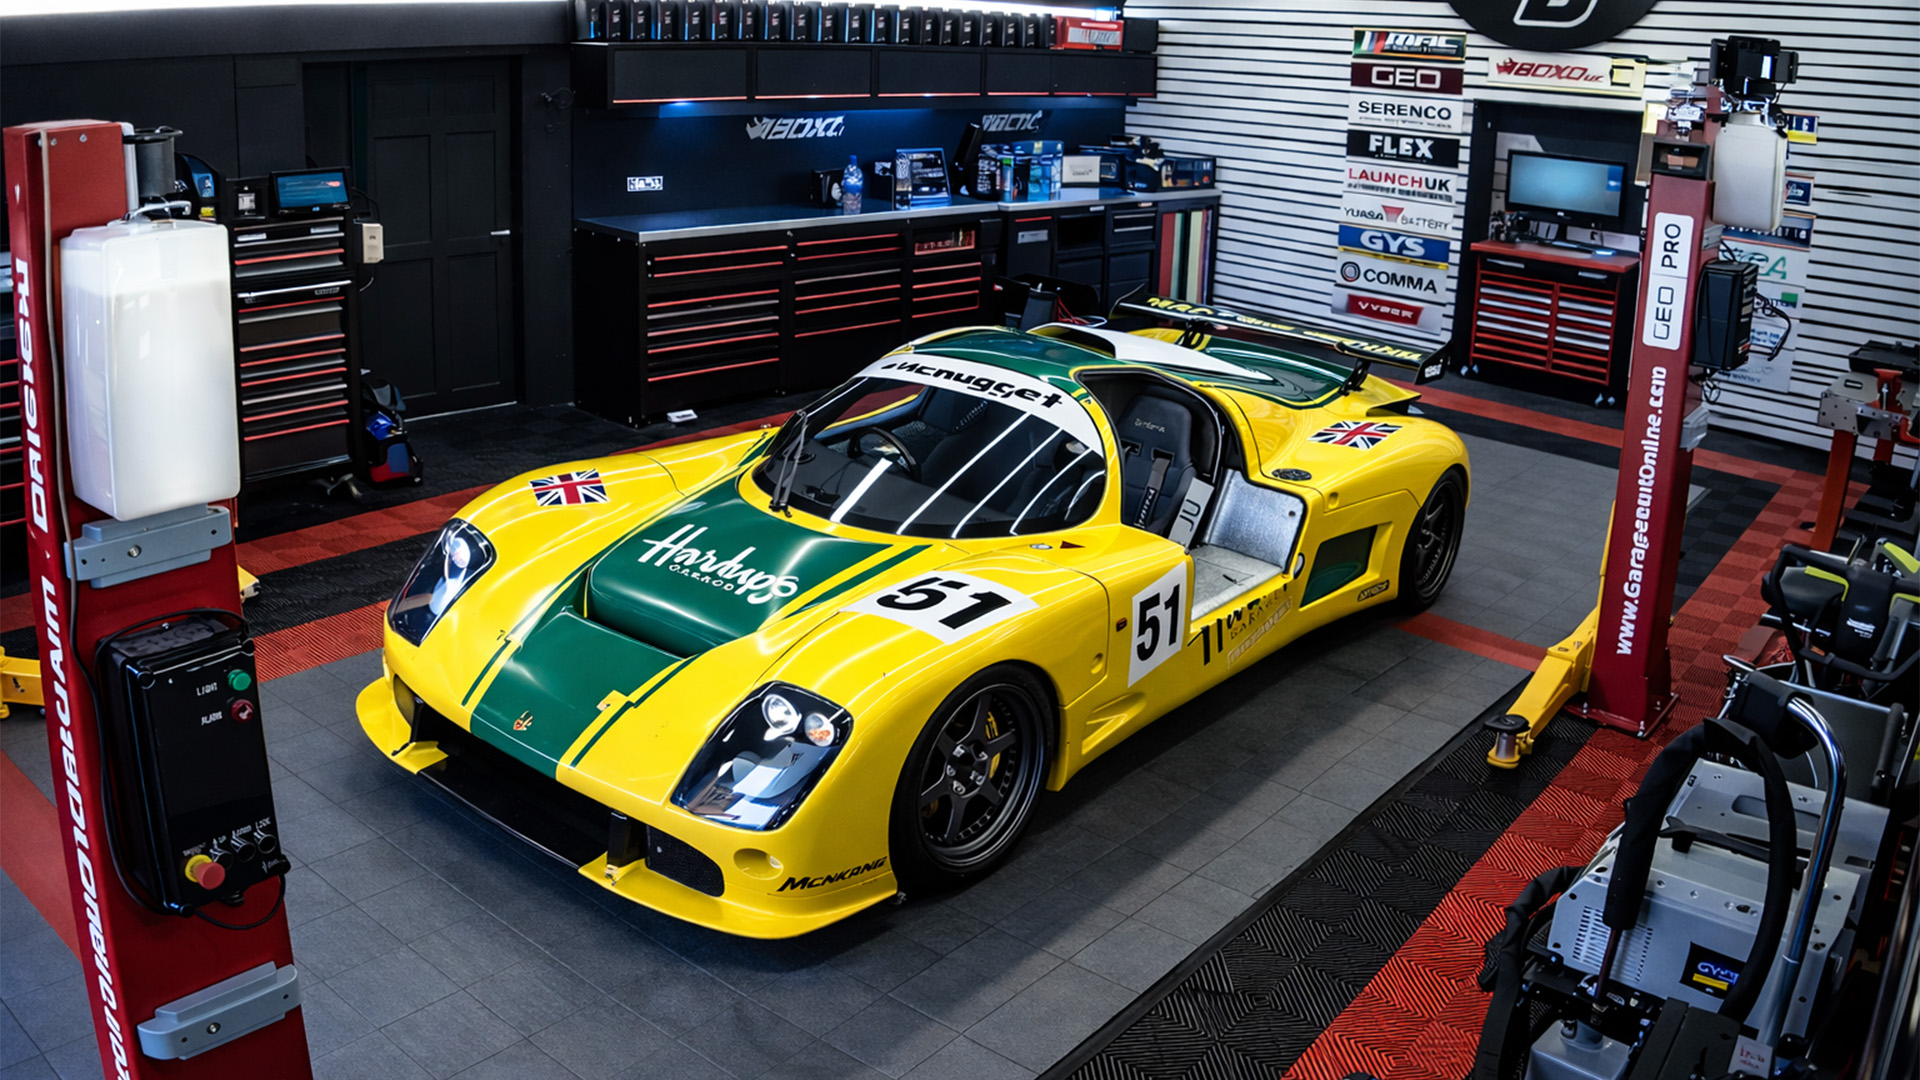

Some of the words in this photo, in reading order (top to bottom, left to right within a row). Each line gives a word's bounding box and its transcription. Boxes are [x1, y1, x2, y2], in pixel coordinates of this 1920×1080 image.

[1371, 66, 1442, 89] GEO
[1358, 101, 1452, 120] SERENCO
[1368, 133, 1434, 159] FLEX
[1360, 230, 1425, 257] GYS
[1661, 223, 1681, 269] PRO
[1363, 268, 1437, 294] COMMA
[1653, 286, 1675, 340] GEO
[876, 577, 1012, 630] 51
[1136, 583, 1180, 662] 51
